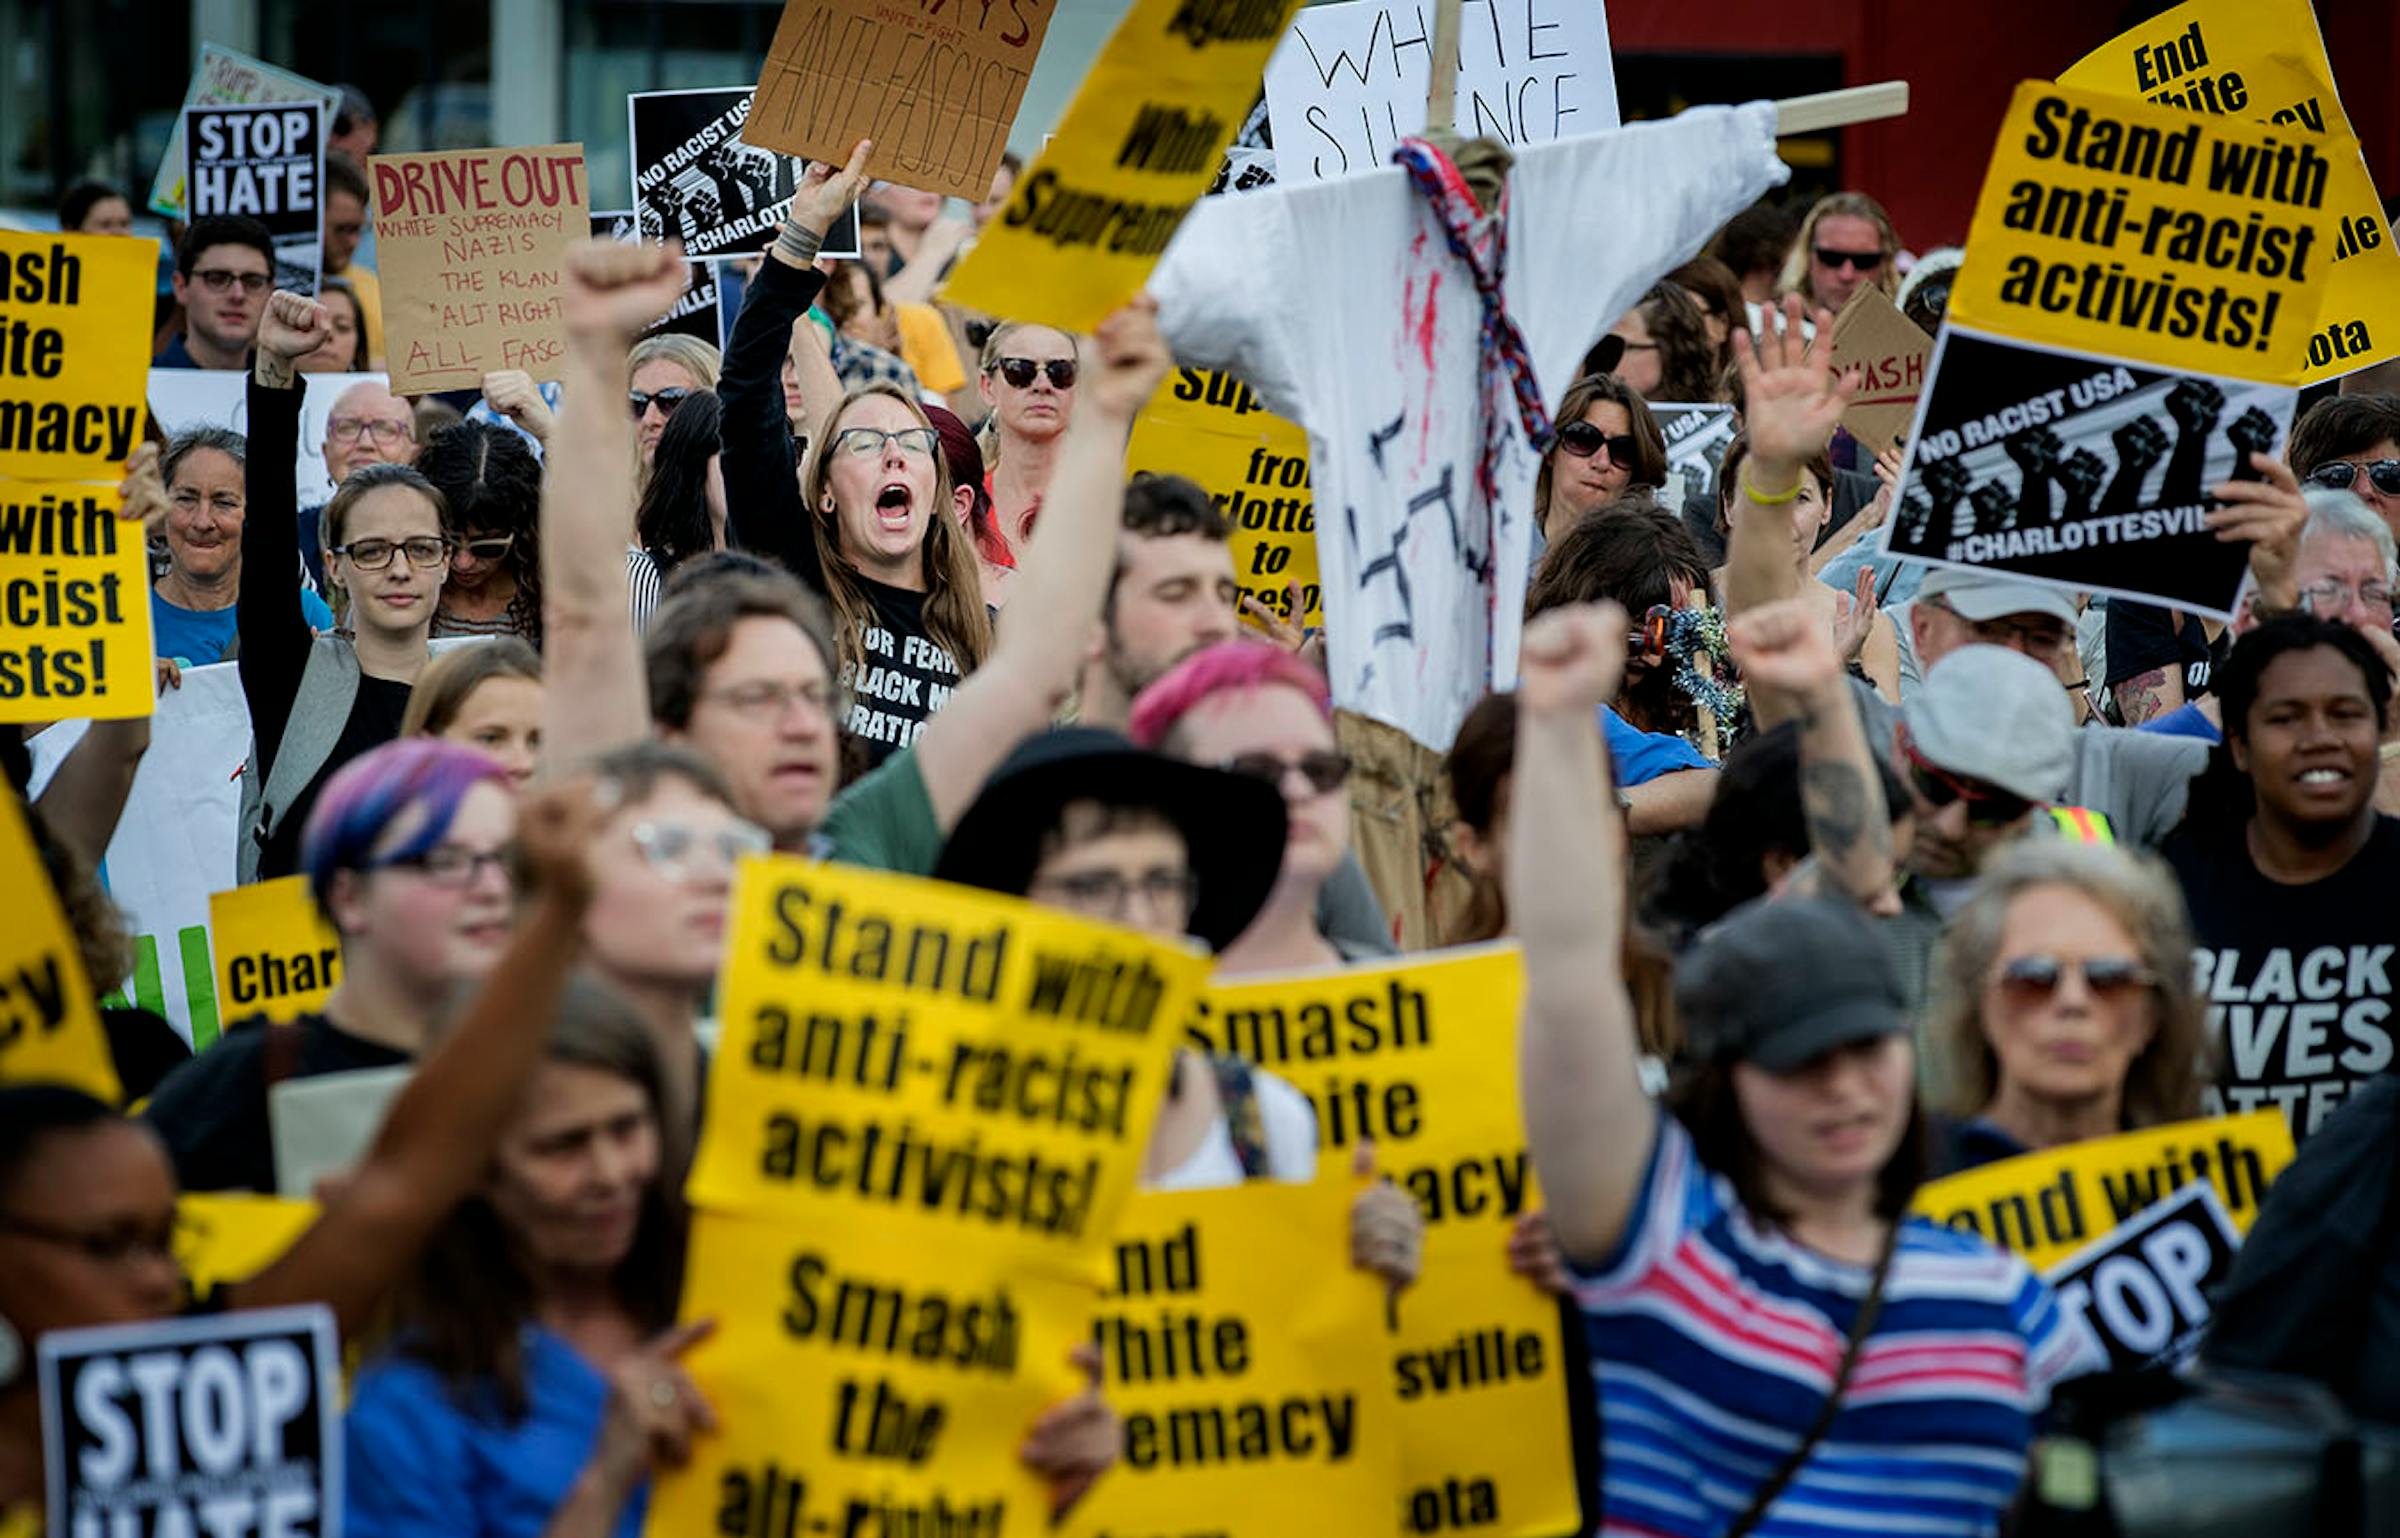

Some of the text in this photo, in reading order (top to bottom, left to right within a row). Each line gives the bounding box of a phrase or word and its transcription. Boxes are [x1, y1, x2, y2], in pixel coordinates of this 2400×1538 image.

[875, 5, 967, 44] UNITE FIGHT
[1294, 0, 1568, 89] WHTE
[2133, 21, 2209, 93] End
[198, 111, 311, 160] STOP
[754, 6, 1028, 192] ANTI-FASCIST
[637, 93, 757, 192] NO RACIST US
[2024, 96, 2330, 209] Stand with
[193, 162, 315, 216] HATE
[374, 154, 584, 217] DRIVE OUT
[376, 211, 563, 239] WHITE SUPREMACY
[443, 231, 535, 265] NAZIS
[2002, 179, 2317, 283] anti-racist
[440, 270, 558, 291] THE KLAN
[2000, 254, 2281, 352] activists!
[406, 338, 566, 371] ALL FASC
[2303, 319, 2372, 370] ota
[1915, 368, 2138, 465] NO RACIST USA
[0, 495, 118, 557] with
[1250, 541, 1291, 575] to
[1945, 503, 2224, 563] #CHARLOTTESVIL
[767, 884, 1008, 1004] Stand
[749, 1001, 1140, 1143] anti-racist
[1306, 1075, 1421, 1154] ite
[760, 1111, 1101, 1242] activists!
[782, 1251, 1022, 1378] Smash
[1093, 1314, 1251, 1385] hite
[1394, 1328, 1545, 1401] sville
[73, 1337, 312, 1489] STOP
[829, 1374, 948, 1469] the
[1123, 1393, 1358, 1472] emacy
